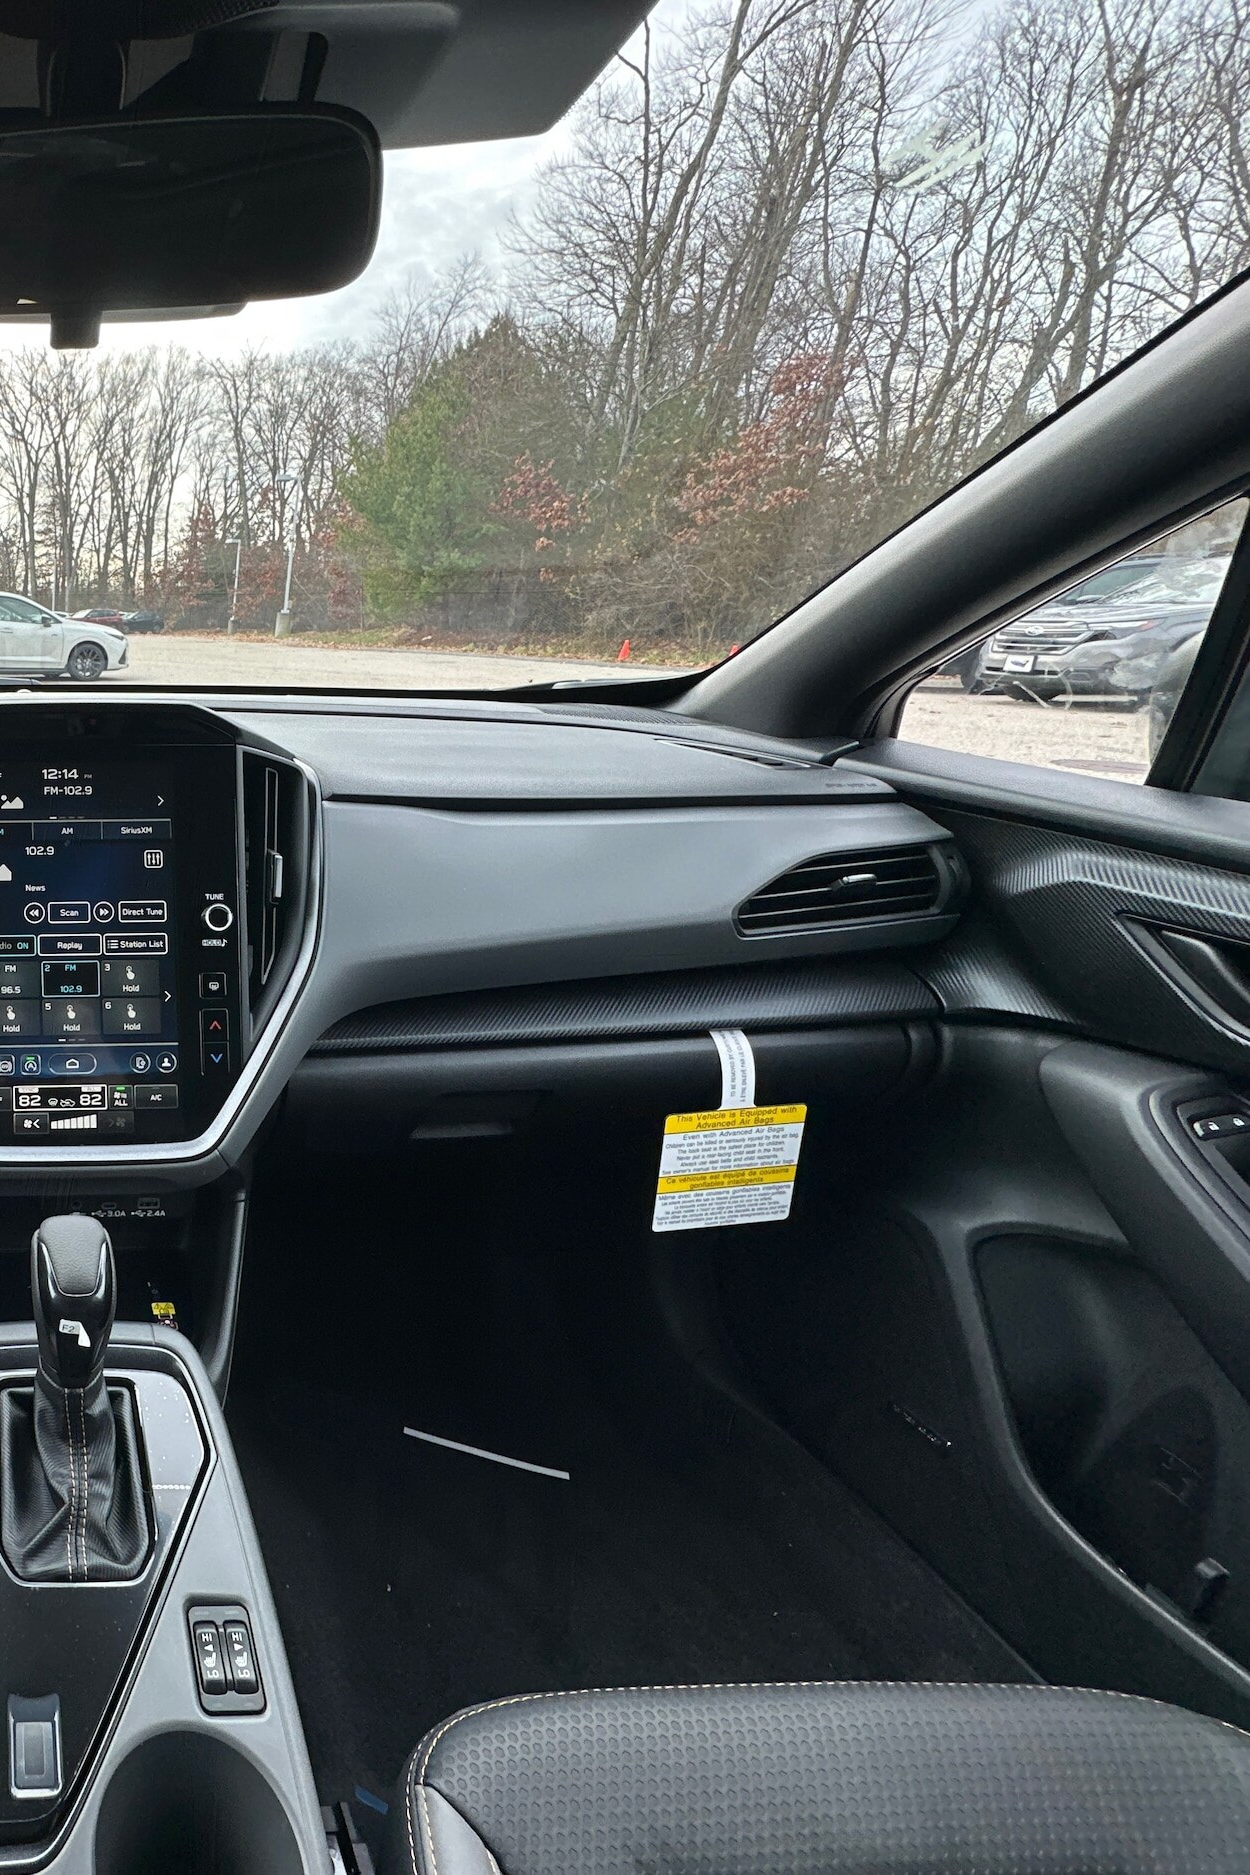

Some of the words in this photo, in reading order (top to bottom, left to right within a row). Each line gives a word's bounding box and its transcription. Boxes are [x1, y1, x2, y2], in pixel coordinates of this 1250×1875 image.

[42, 769, 78, 779] 12:14
[44, 786, 92, 795] FM-102.9
[25, 846, 54, 855] 102.9
[57, 942, 82, 950] Replay
[19, 1096, 41, 1106] 82
[80, 1094, 102, 1105] 82
[740, 1108, 777, 1117] Equipped
[696, 1121, 736, 1129] Advanced
[754, 1117, 774, 1126] Bags
[202, 1633, 212, 1642] HI
[232, 1632, 242, 1641] HI
[207, 1670, 219, 1678] LO
[238, 1669, 250, 1678] LO
